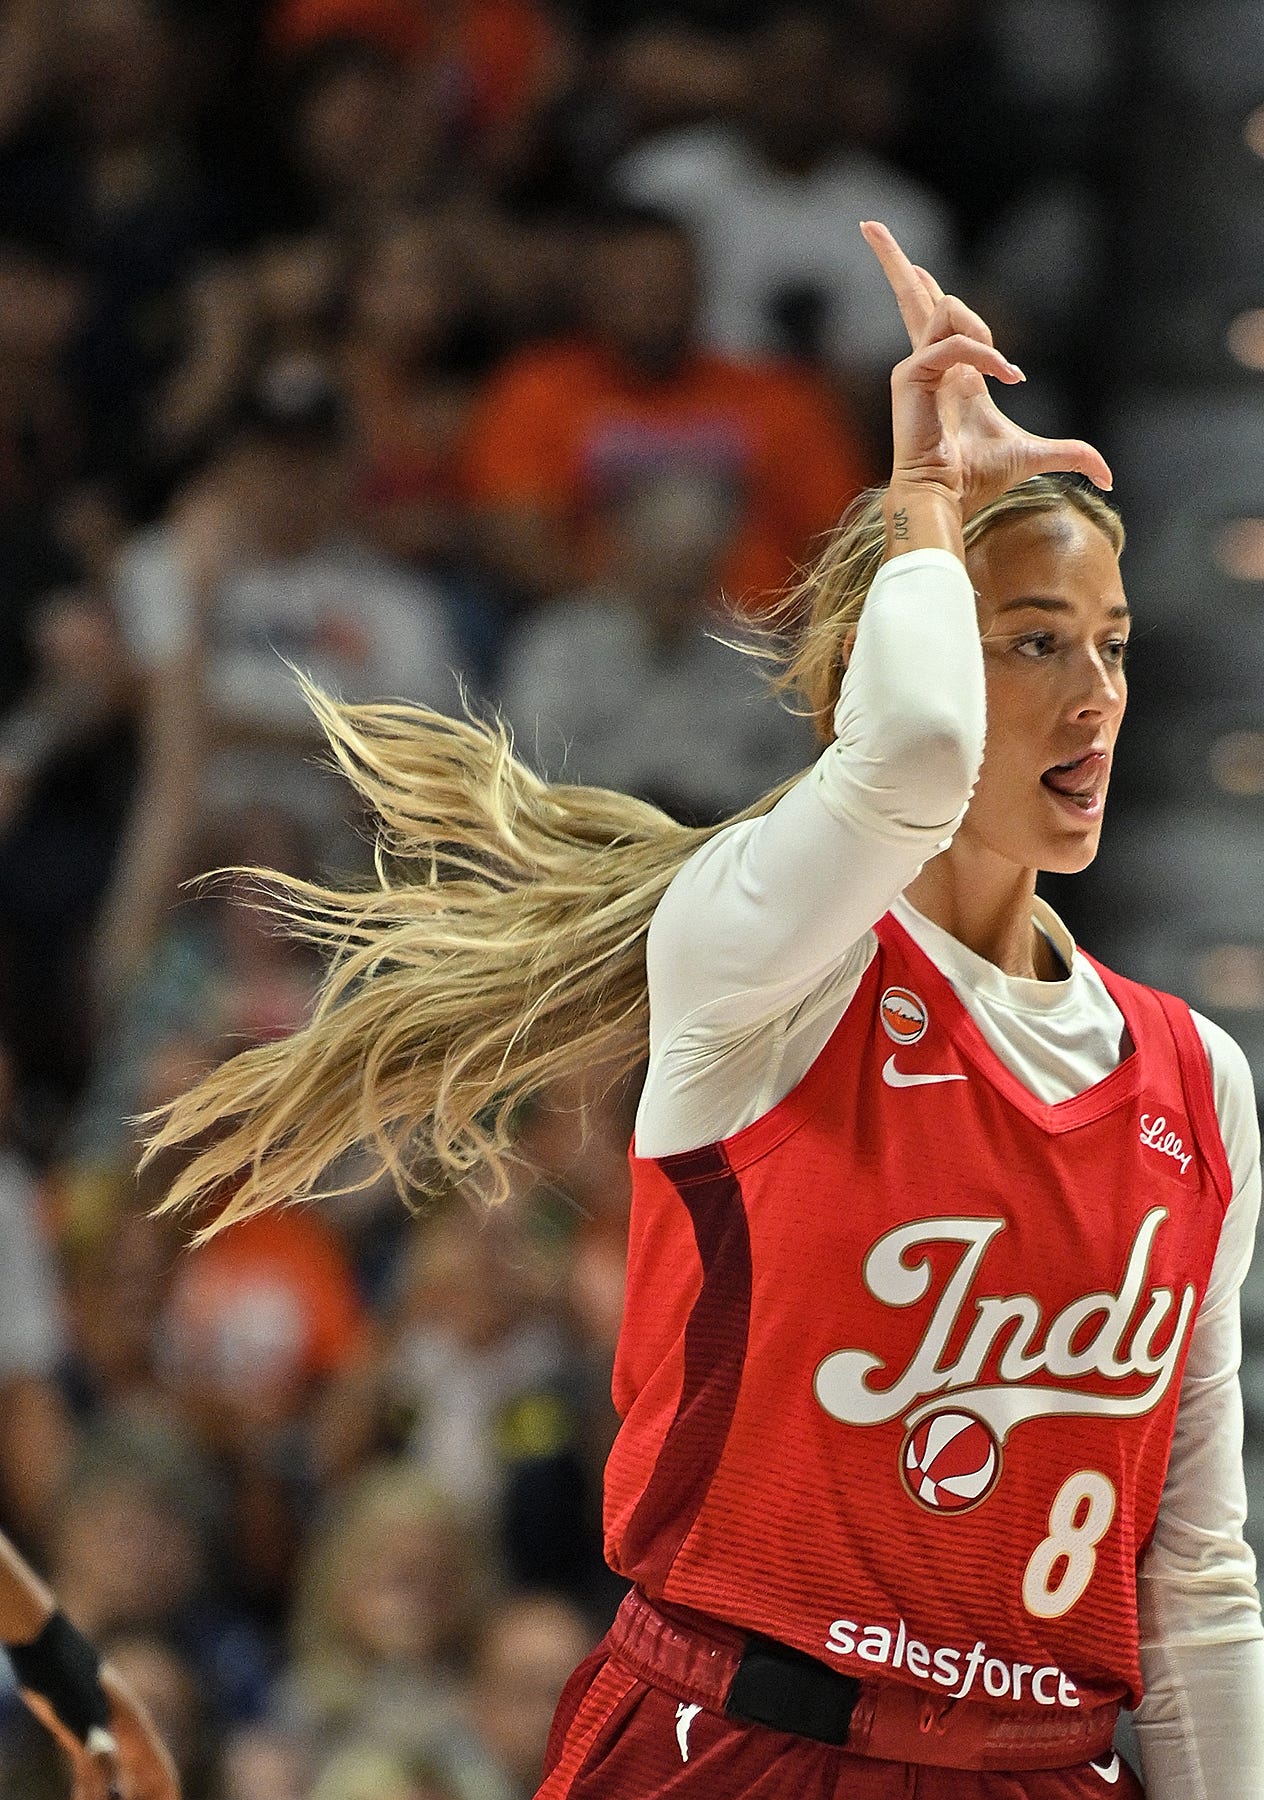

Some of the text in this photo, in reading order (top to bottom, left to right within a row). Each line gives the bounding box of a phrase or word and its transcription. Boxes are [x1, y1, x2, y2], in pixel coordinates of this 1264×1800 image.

[1139, 1113, 1193, 1175] Lilly
[813, 1206, 1195, 1430] Indy
[1022, 1470, 1116, 1619] 8
[825, 1618, 1081, 1708] salesforce
